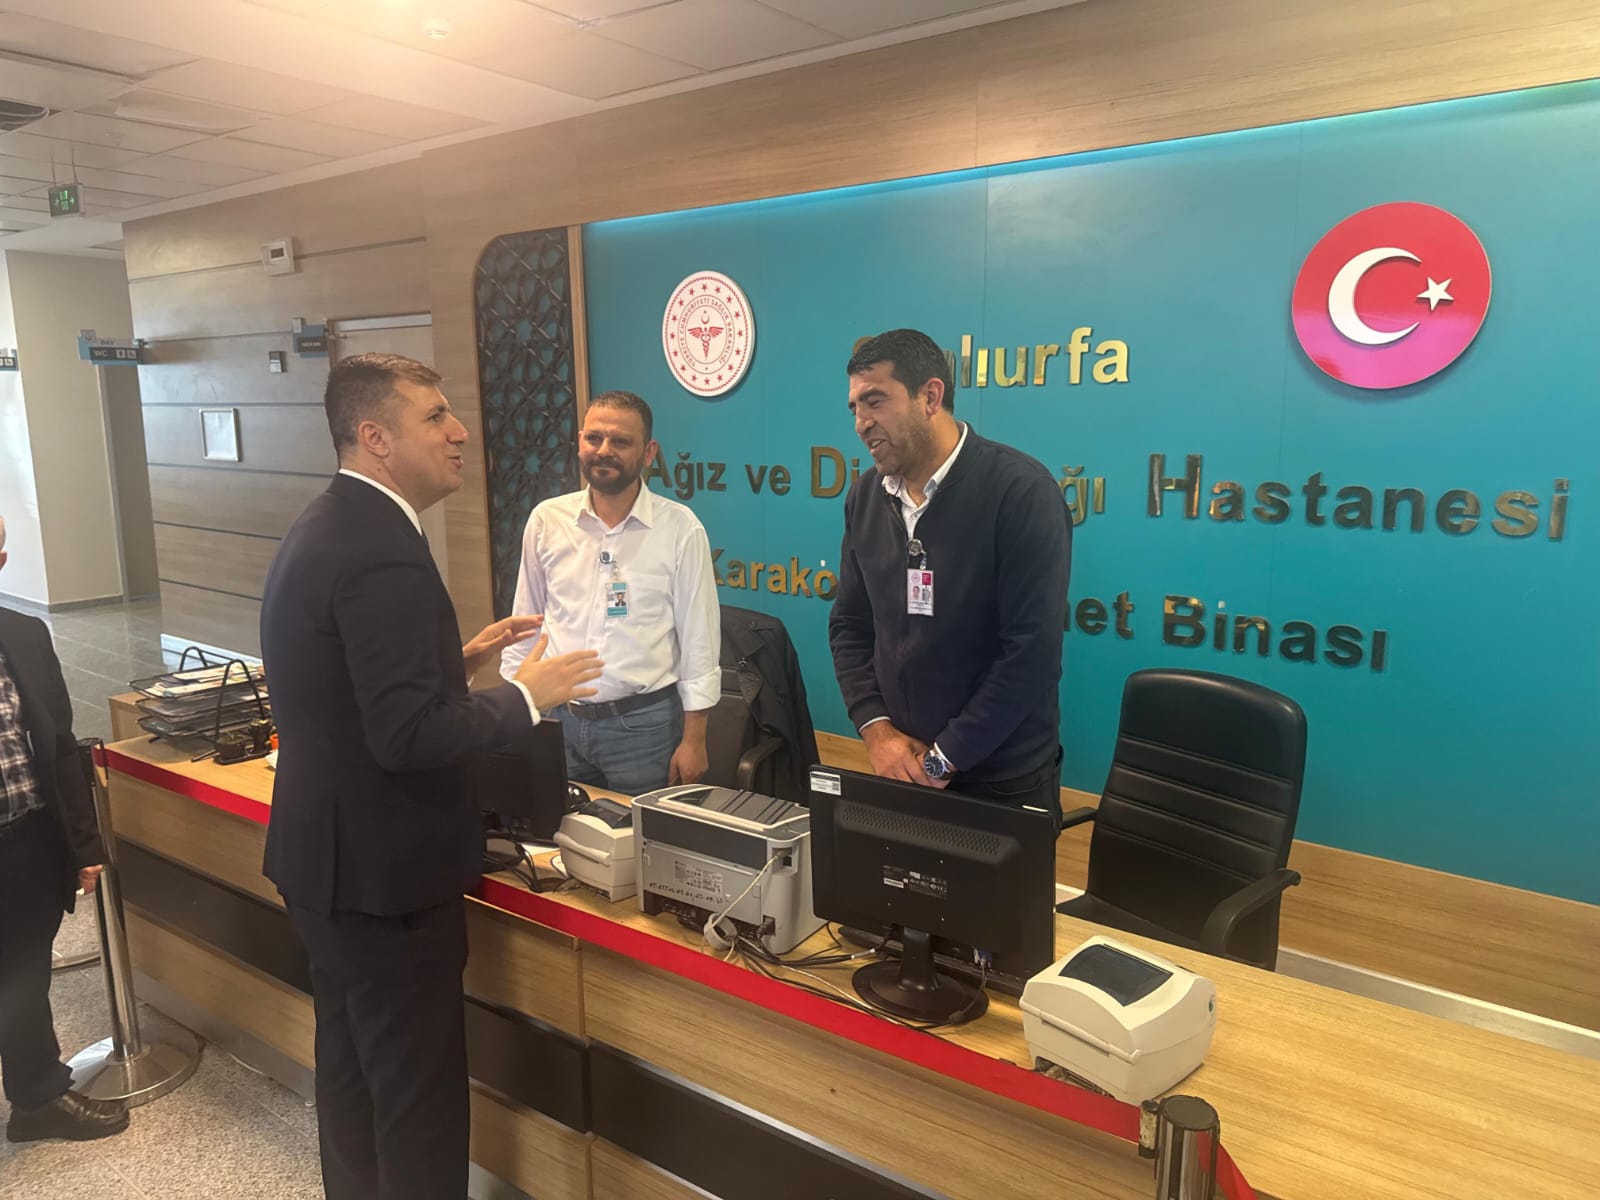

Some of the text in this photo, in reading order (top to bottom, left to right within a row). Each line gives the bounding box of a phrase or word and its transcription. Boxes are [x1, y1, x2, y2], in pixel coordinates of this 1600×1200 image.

[854, 327, 1129, 388] lıurfa
[645, 448, 727, 500] Ağız
[744, 463, 792, 496] ve
[810, 446, 861, 499] Di
[1147, 453, 1570, 541] Hastanesi
[711, 548, 838, 601] Karakö
[1162, 594, 1390, 673] Binası
